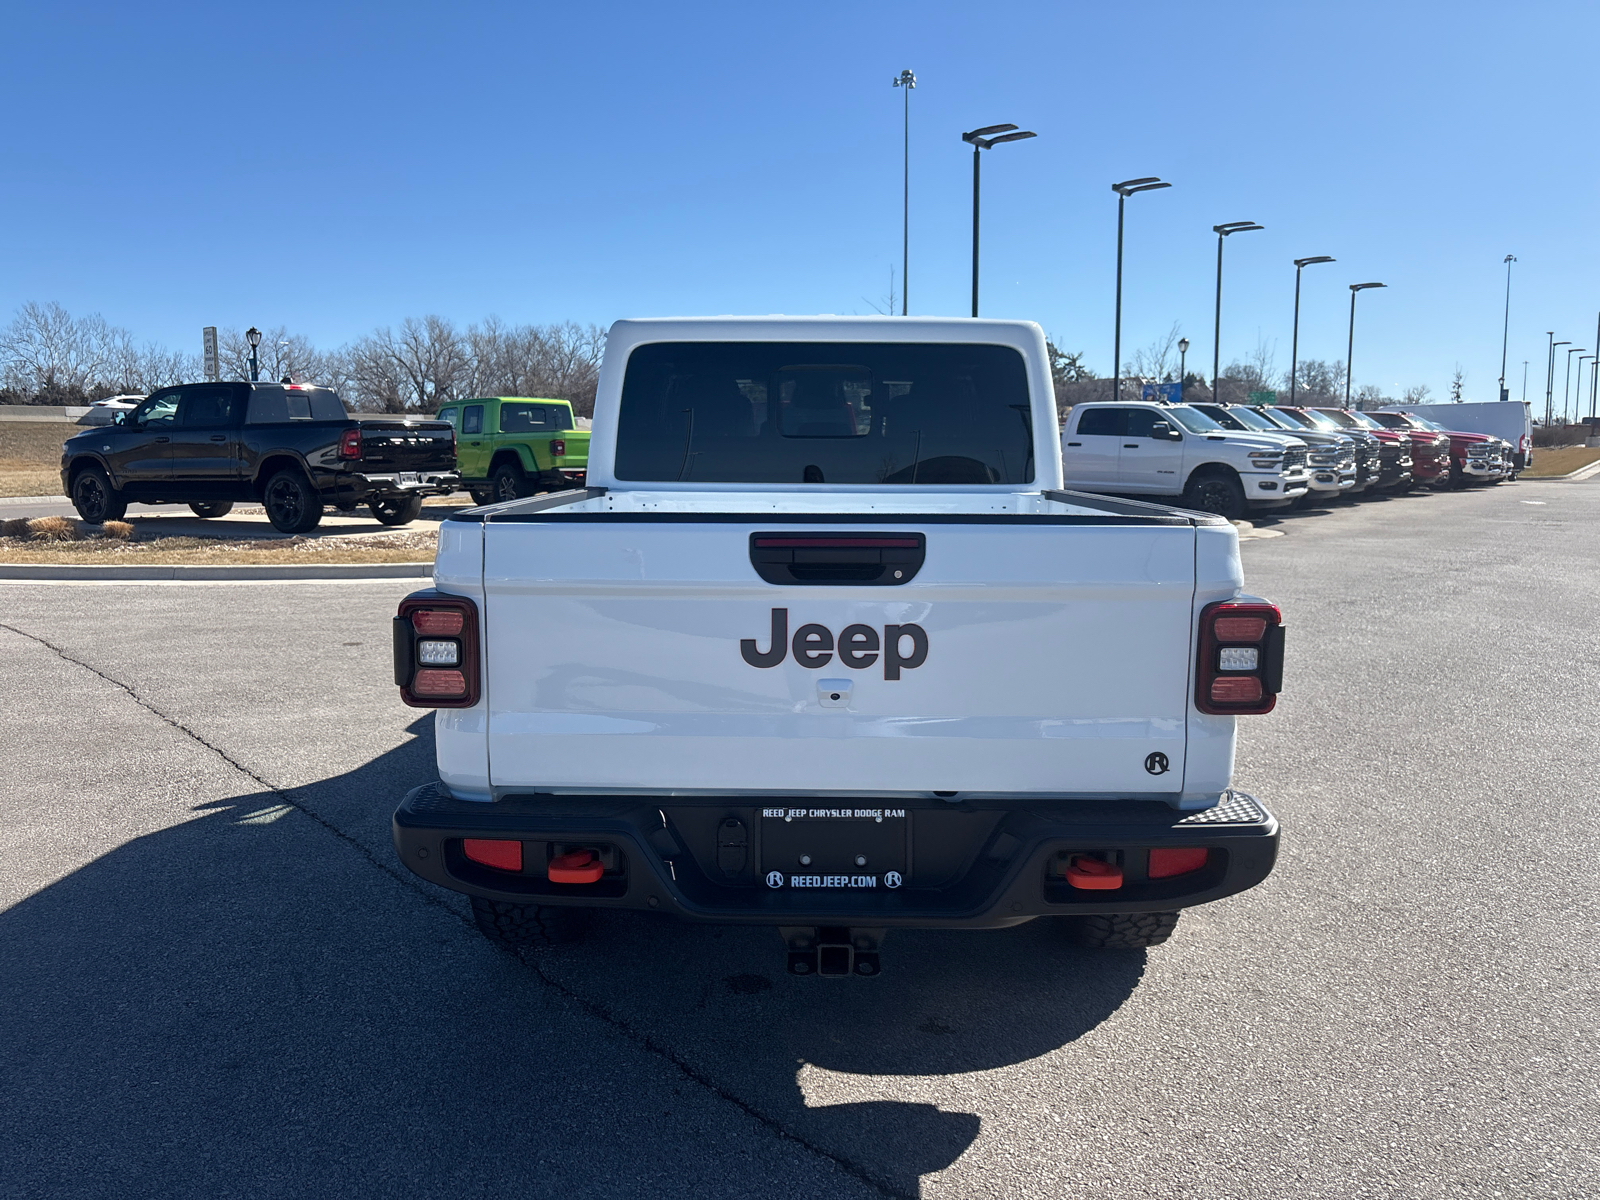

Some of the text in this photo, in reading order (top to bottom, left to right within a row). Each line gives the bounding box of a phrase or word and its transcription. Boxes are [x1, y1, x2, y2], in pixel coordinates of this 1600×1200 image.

[740, 607, 929, 681] Jeep
[762, 808, 905, 818] REED JEEP CHRYSLER DODGE RAM
[790, 875, 877, 888] REEDJEEP.COM
